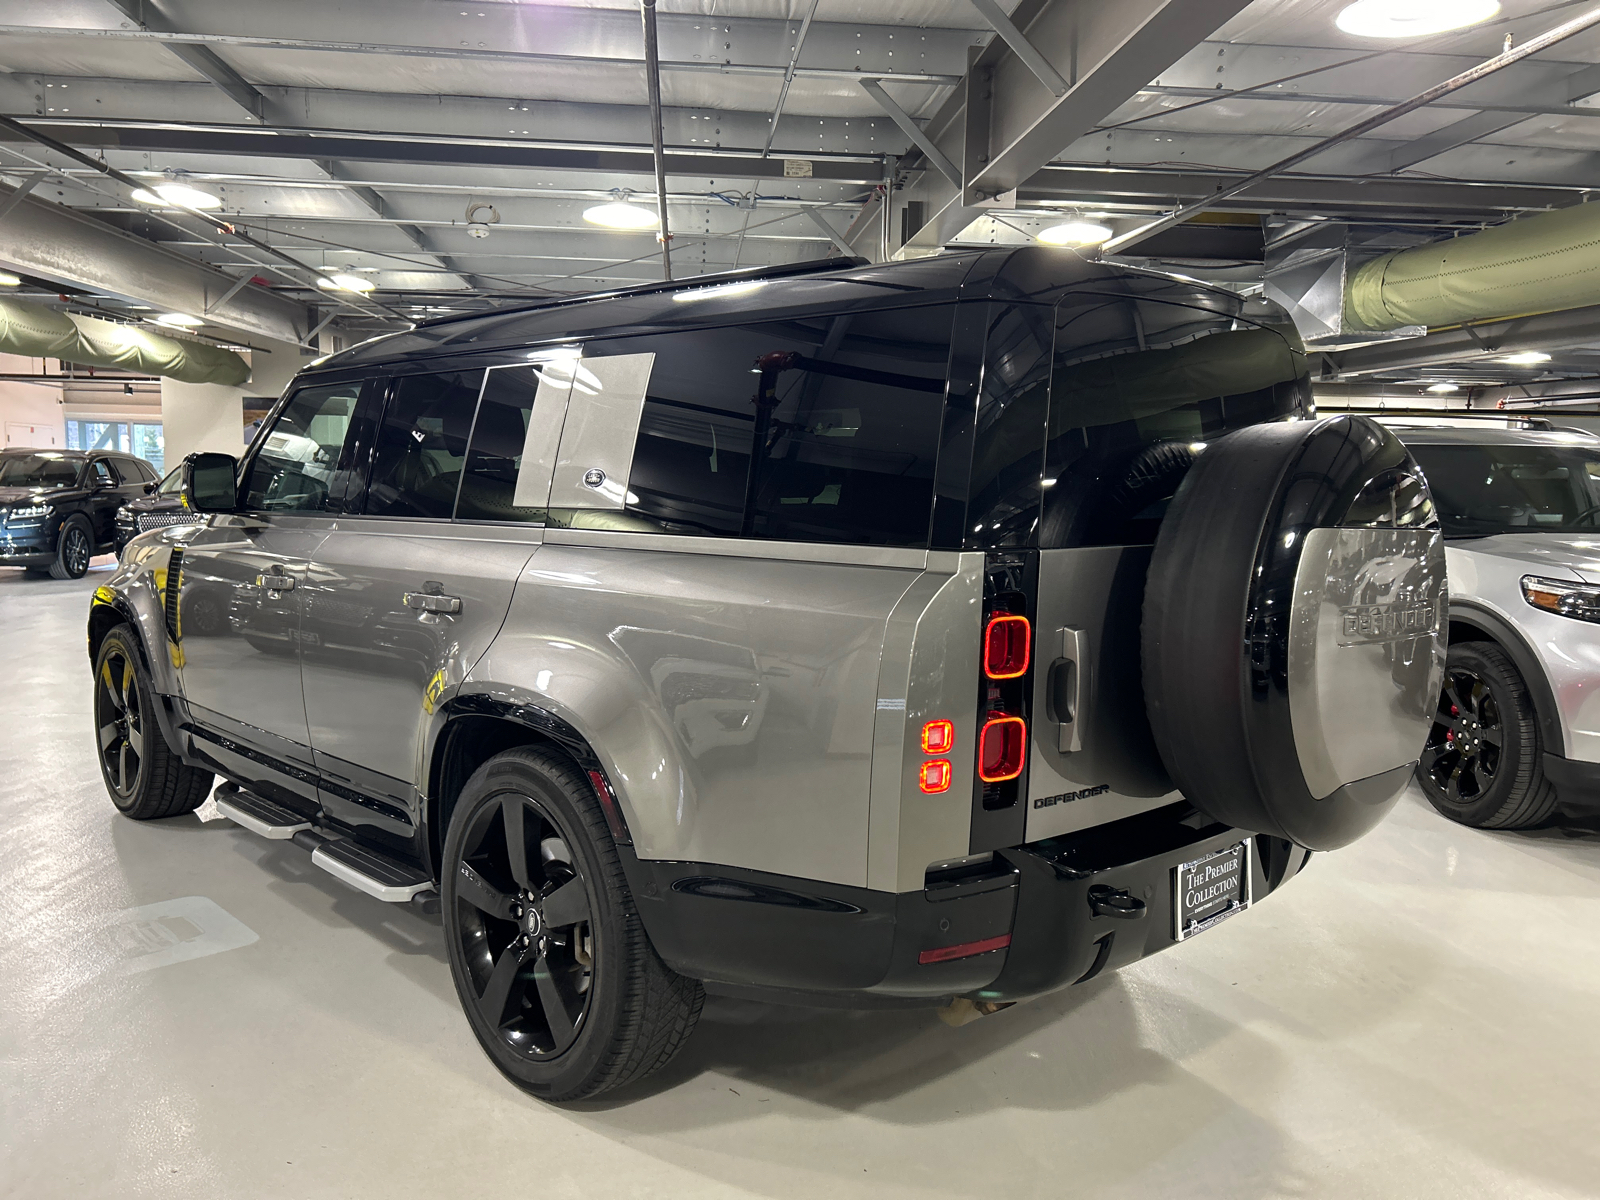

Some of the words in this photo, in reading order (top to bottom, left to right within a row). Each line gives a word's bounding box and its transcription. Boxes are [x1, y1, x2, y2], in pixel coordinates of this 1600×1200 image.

[1034, 784, 1110, 809] DEFENDER
[1187, 873, 1205, 890] THE
[1205, 858, 1238, 882] PREMIER
[1186, 875, 1238, 908] COLLECTION
